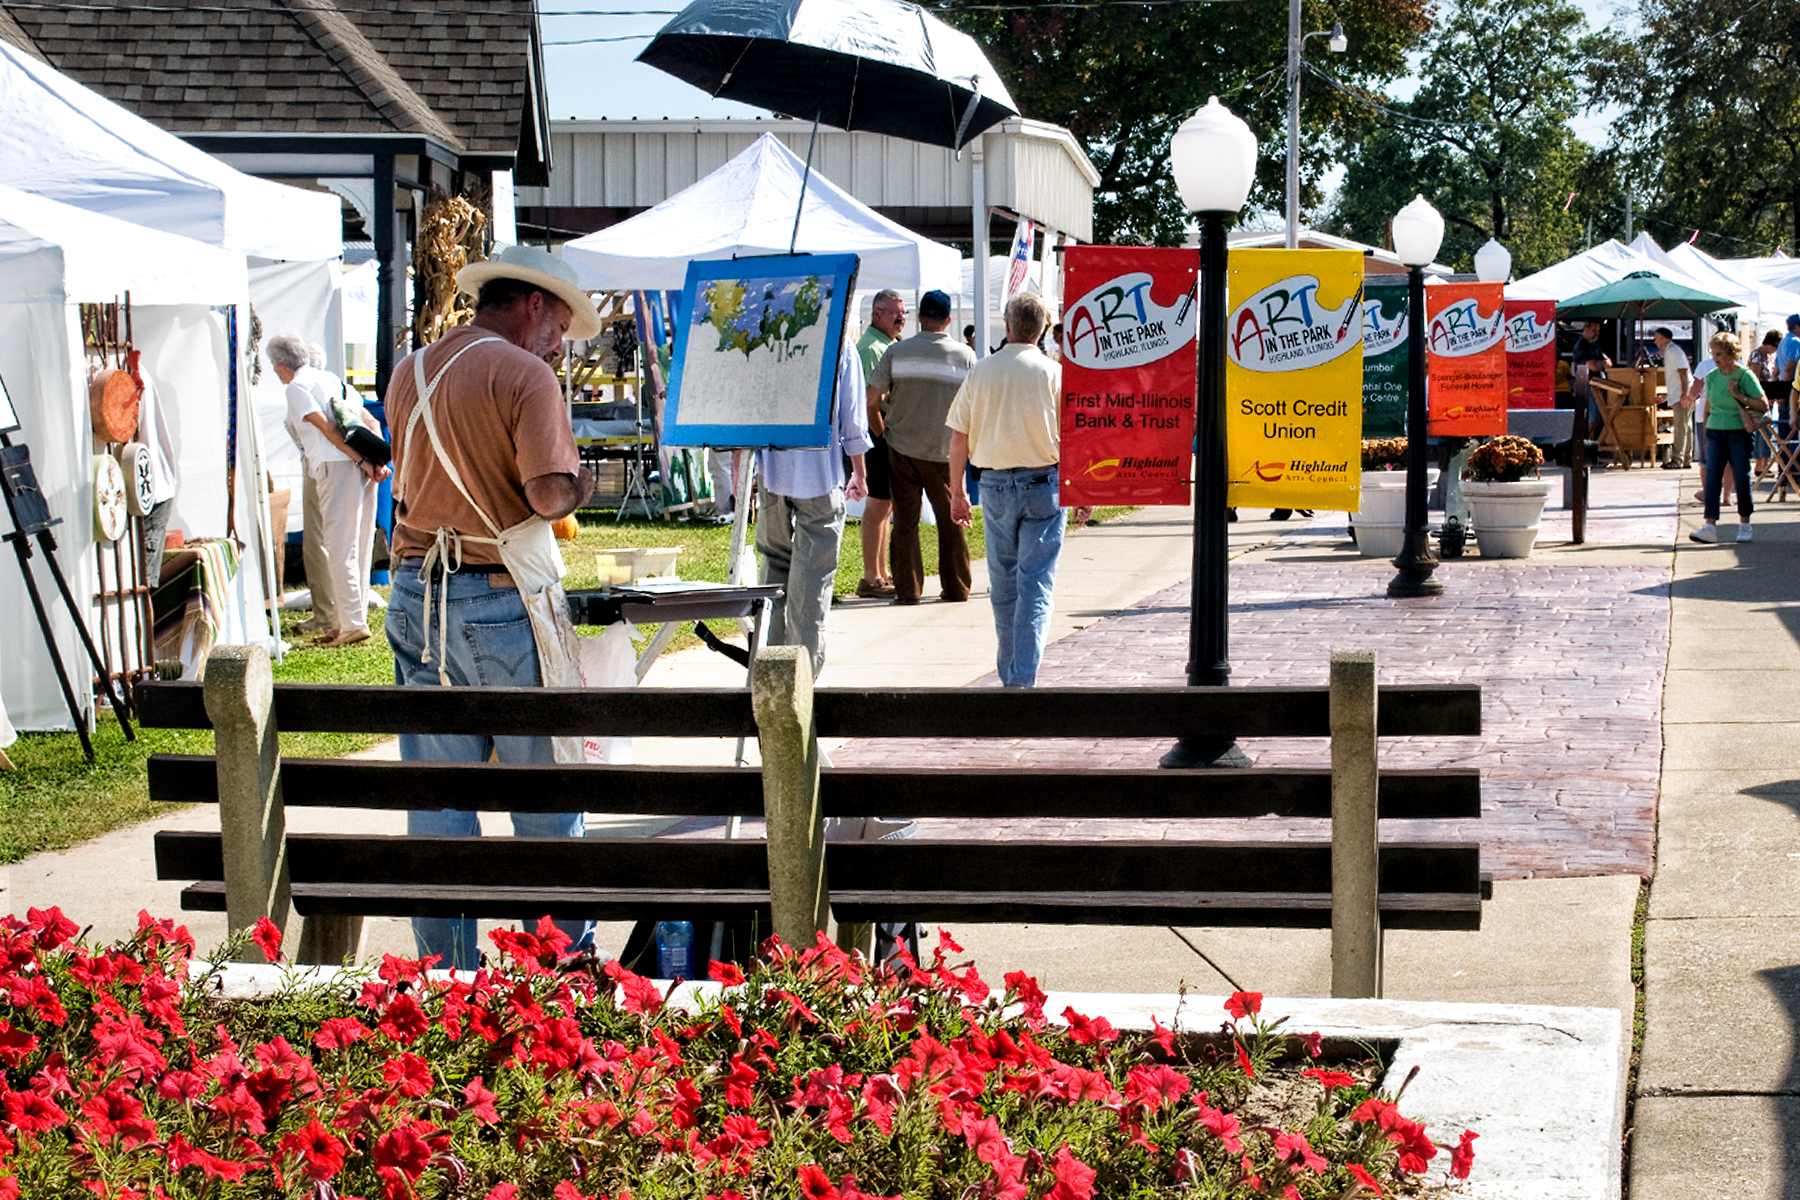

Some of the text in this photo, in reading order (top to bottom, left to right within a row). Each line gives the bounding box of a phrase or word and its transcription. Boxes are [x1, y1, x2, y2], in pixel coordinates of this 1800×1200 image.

[1066, 281, 1151, 358] ART
[1231, 284, 1317, 361] ART
[1429, 303, 1477, 352] ART
[1100, 321, 1166, 351] IN THE PARK
[1265, 324, 1332, 354] IN THE PARK
[1065, 392, 1192, 409] First Mid-Illinois
[1240, 398, 1287, 416] Scott
[1293, 399, 1348, 417] Credit
[1075, 413, 1180, 429] Bank & Trust
[1263, 422, 1316, 439] Union
[1121, 457, 1180, 470] Highland
[1290, 460, 1348, 474] Highland
[1285, 474, 1305, 482] Arts
